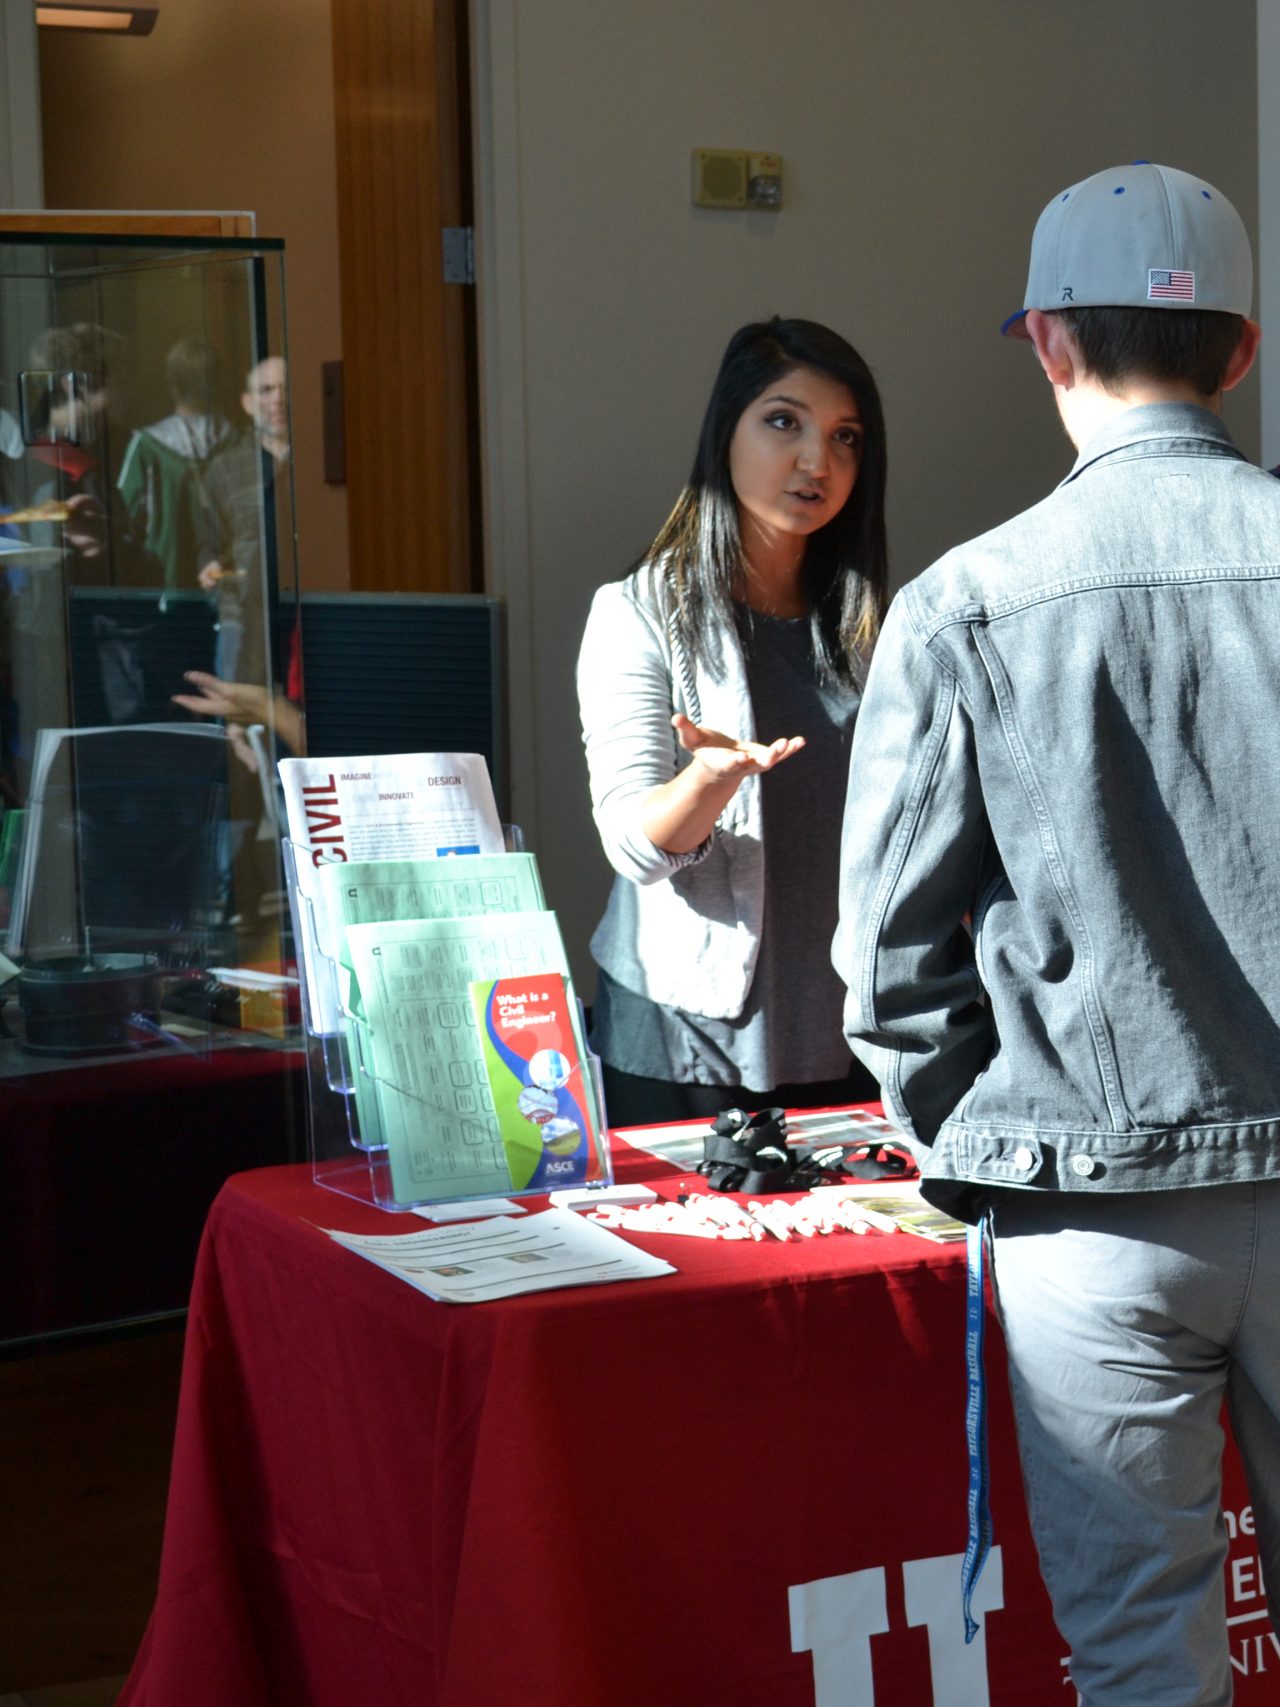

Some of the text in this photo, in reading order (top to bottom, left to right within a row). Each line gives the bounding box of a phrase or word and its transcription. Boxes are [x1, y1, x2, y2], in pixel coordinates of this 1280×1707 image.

[340, 772, 372, 782] IMAGINE
[427, 775, 462, 787] DESIGN
[302, 773, 348, 869] CIVIL
[496, 992, 550, 1006] What is a
[499, 1004, 525, 1016] Civil
[501, 1011, 557, 1029] Engineer?
[545, 1161, 575, 1175] ASCE
[969, 1331, 979, 1381] BASEBALL
